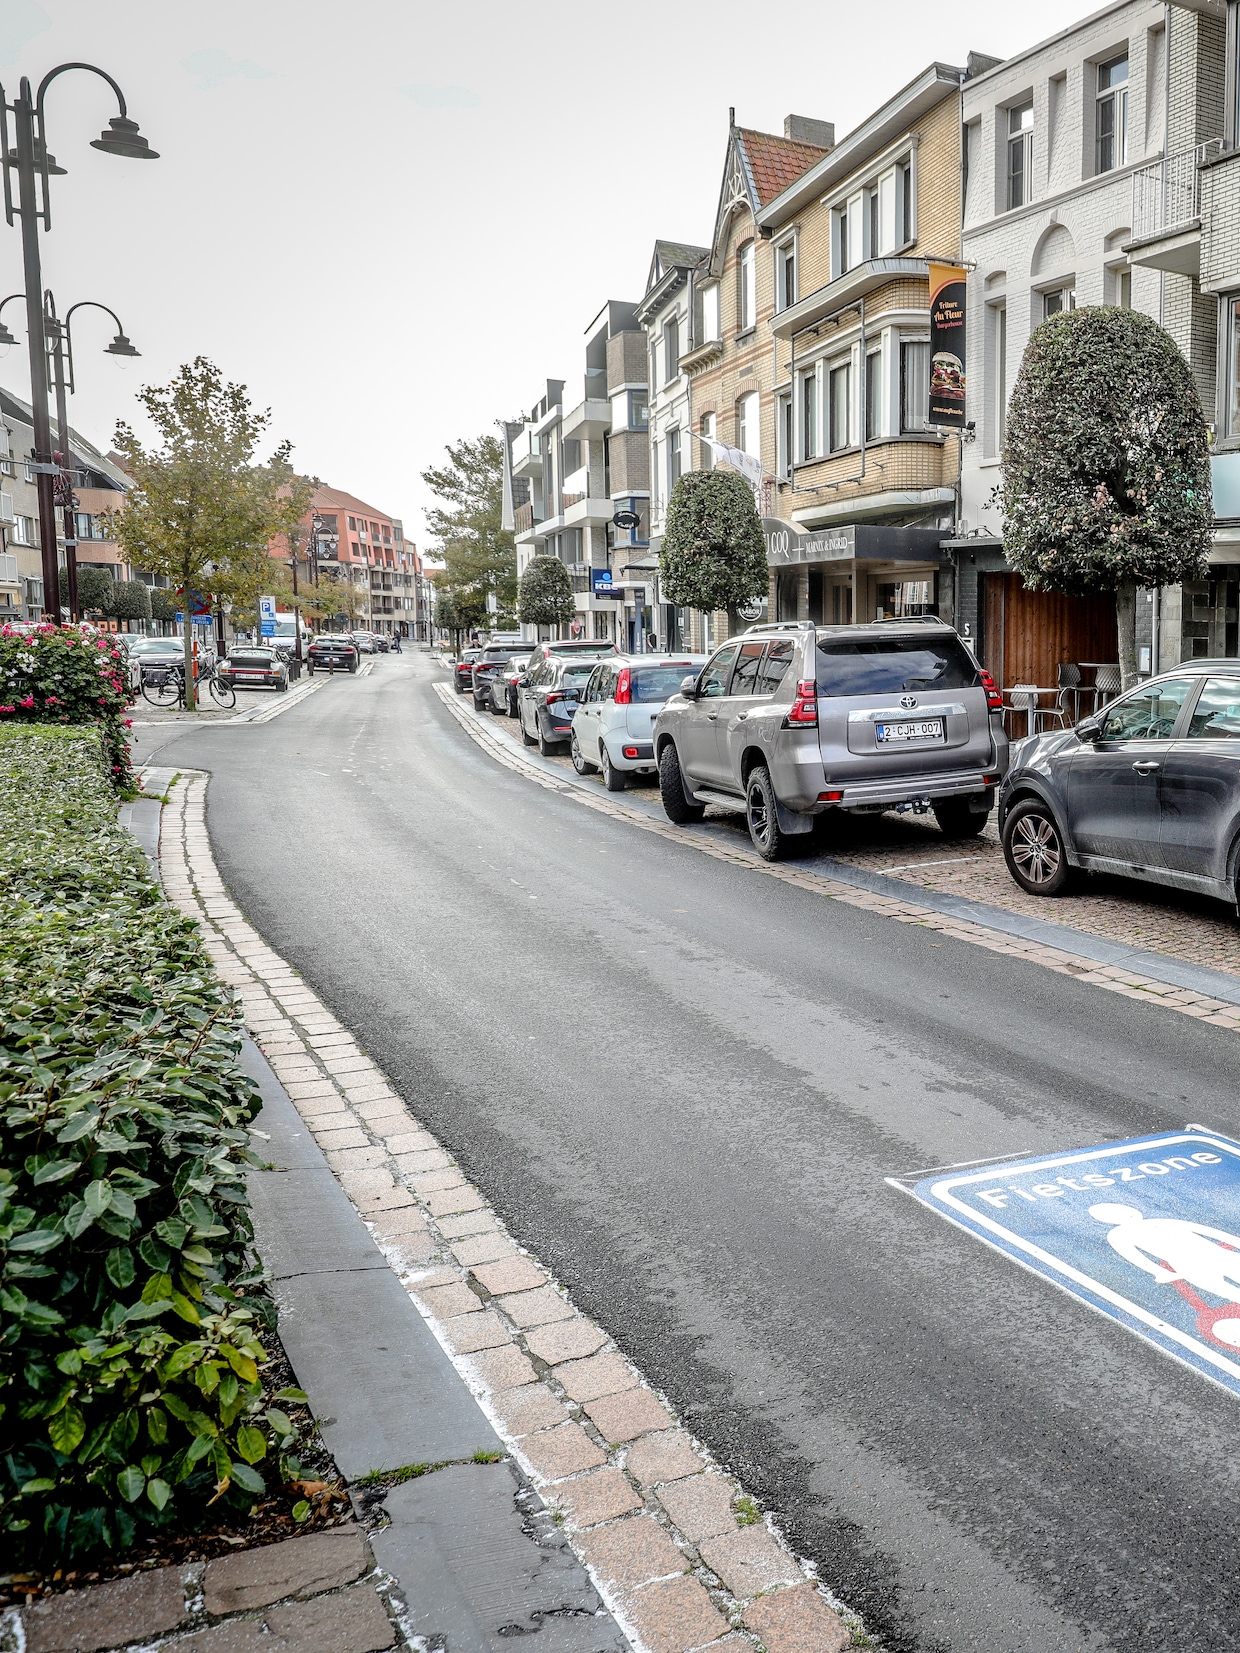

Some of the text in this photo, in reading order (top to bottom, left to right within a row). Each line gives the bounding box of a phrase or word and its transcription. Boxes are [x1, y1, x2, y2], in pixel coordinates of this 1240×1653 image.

[934, 310, 963, 322] Au Fleur
[771, 530, 790, 558] COQ
[964, 623, 970, 636] 5
[974, 1151, 1223, 1208] Fietszone
